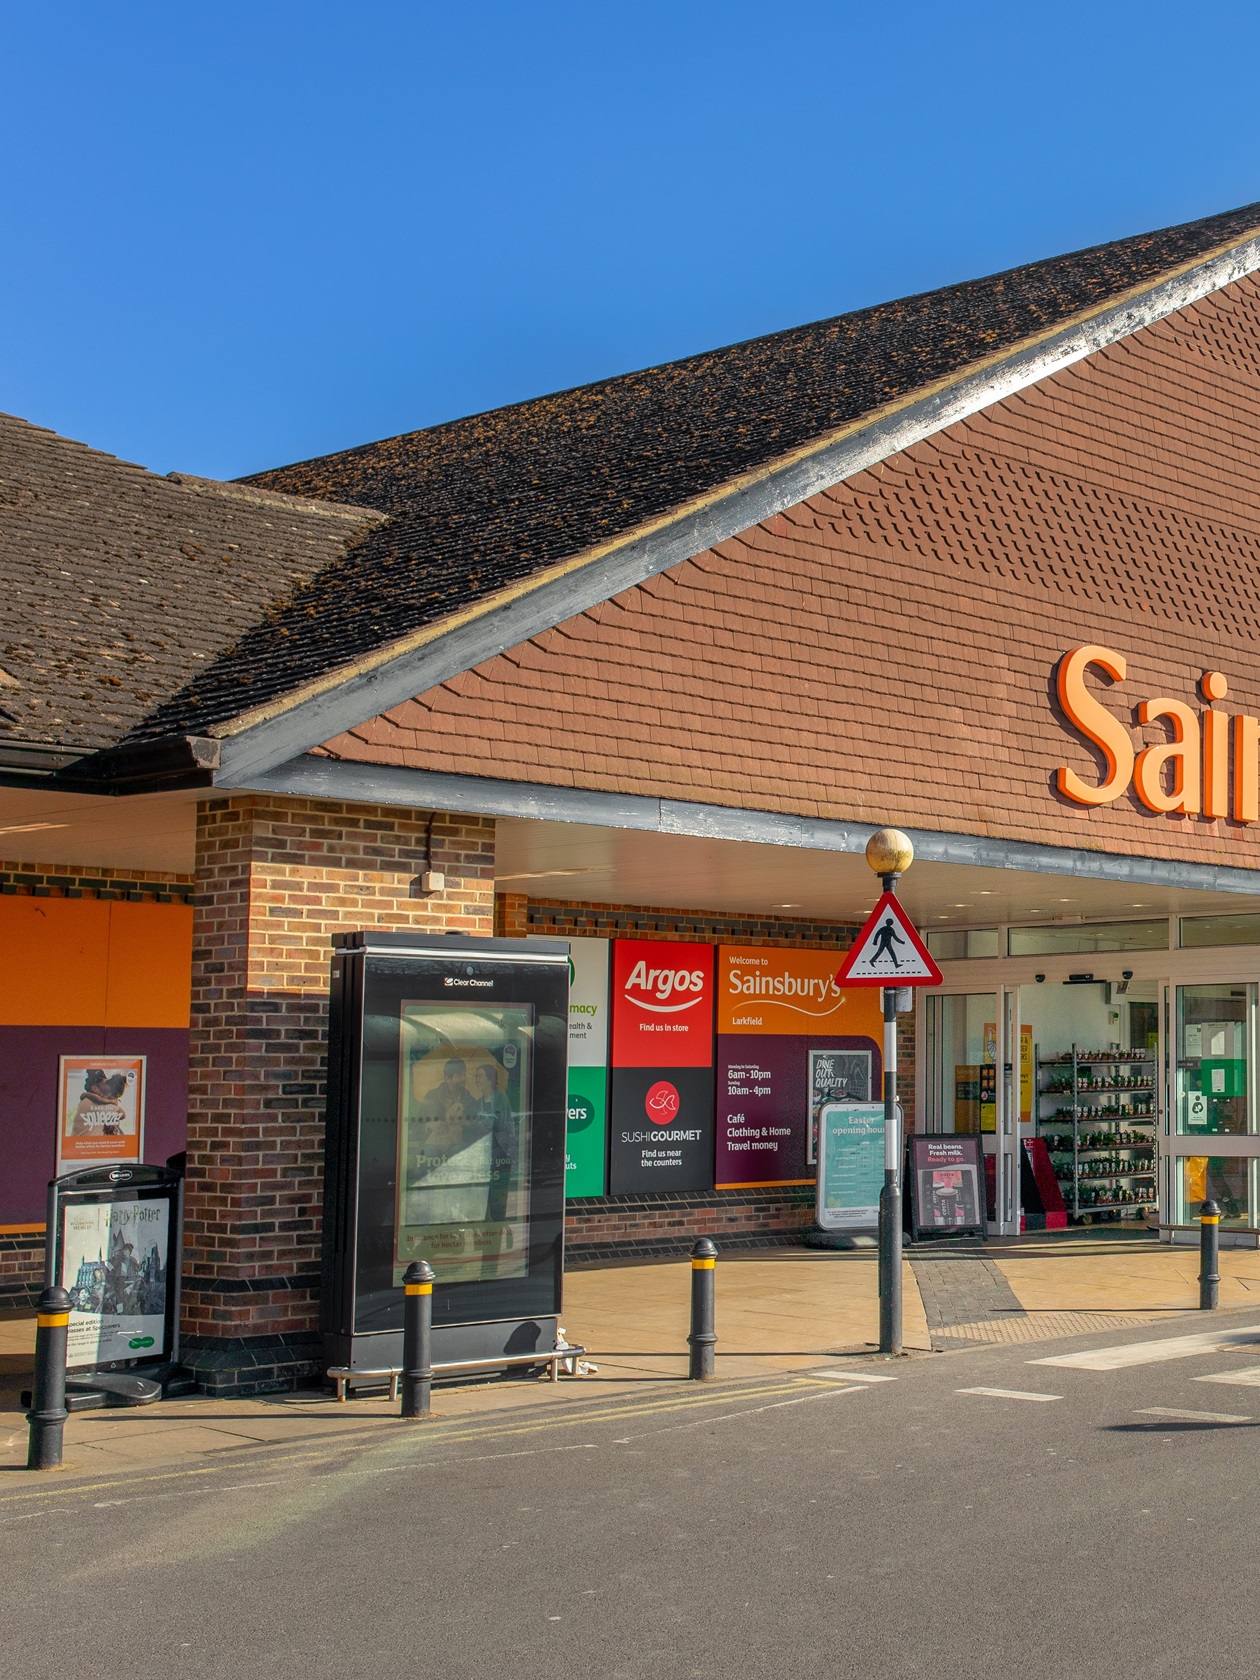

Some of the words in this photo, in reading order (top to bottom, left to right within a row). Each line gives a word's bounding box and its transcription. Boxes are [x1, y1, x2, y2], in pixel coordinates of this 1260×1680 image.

[729, 956, 760, 965] Welcome
[625, 961, 704, 999] Argos
[729, 970, 840, 1002] Sainsbury's
[570, 1005, 597, 1016] macy
[733, 1017, 762, 1025] Larkfield
[816, 1059, 834, 1069] DINE
[816, 1078, 847, 1088] QUALITY
[80, 1111, 123, 1131] squeeze
[727, 1114, 744, 1123] Café
[848, 1116, 875, 1124] Easter
[727, 1127, 760, 1138] Clothing
[761, 1127, 768, 1136] &
[769, 1127, 791, 1135] Home
[832, 1127, 866, 1135] opening
[727, 1141, 750, 1151] Travel
[752, 1142, 778, 1151] money
[496, 1157, 512, 1167] you
[474, 1169, 500, 1181] less
[133, 1204, 160, 1225] Potter
